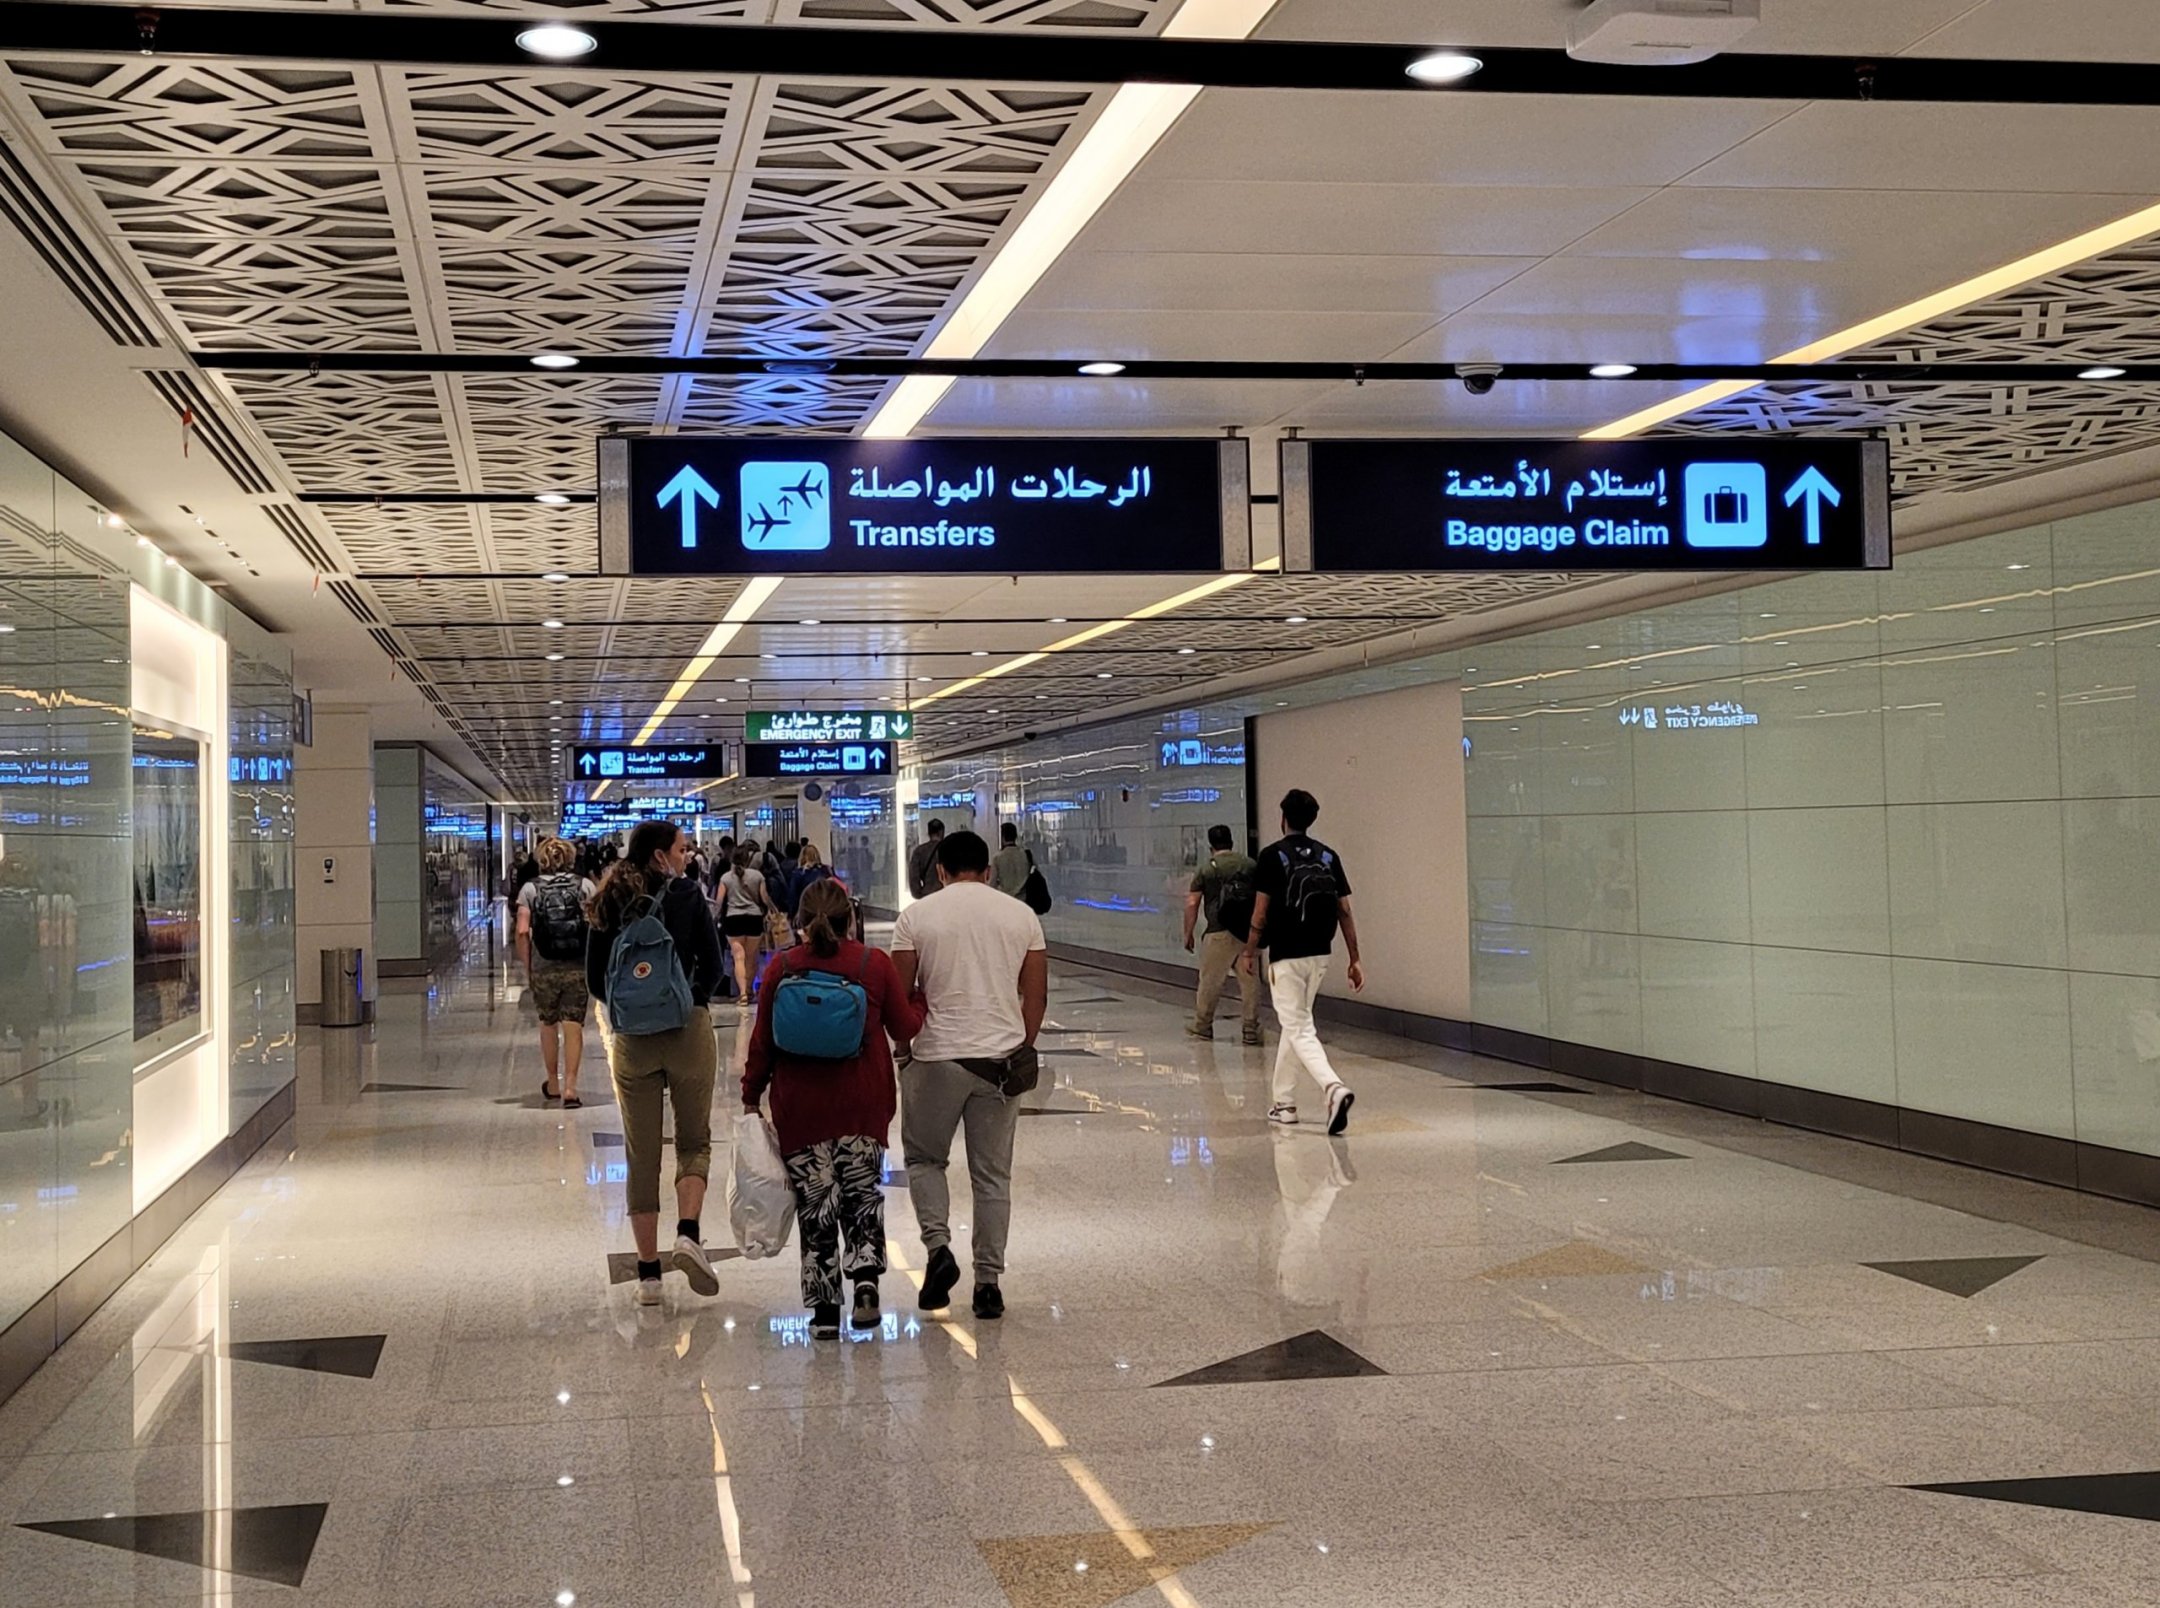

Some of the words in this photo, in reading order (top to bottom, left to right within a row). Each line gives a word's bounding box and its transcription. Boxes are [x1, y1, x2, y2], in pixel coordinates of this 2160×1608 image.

[848, 465, 996, 507] المواصلة
[1010, 465, 1152, 507] الرحلات
[1444, 459, 1552, 499] الأمتعة
[1565, 467, 1670, 513] إستلام
[849, 519, 996, 547] Transfers
[1446, 519, 1577, 552] Baggage
[1584, 518, 1670, 546] Claim
[771, 711, 819, 729] طوارئ
[822, 712, 862, 728] مخرج
[759, 729, 832, 740] EMERGENCY
[835, 729, 862, 740] EXIT
[626, 765, 666, 774] Transfers
[779, 762, 815, 771] Baggage
[816, 761, 841, 771] Claim
